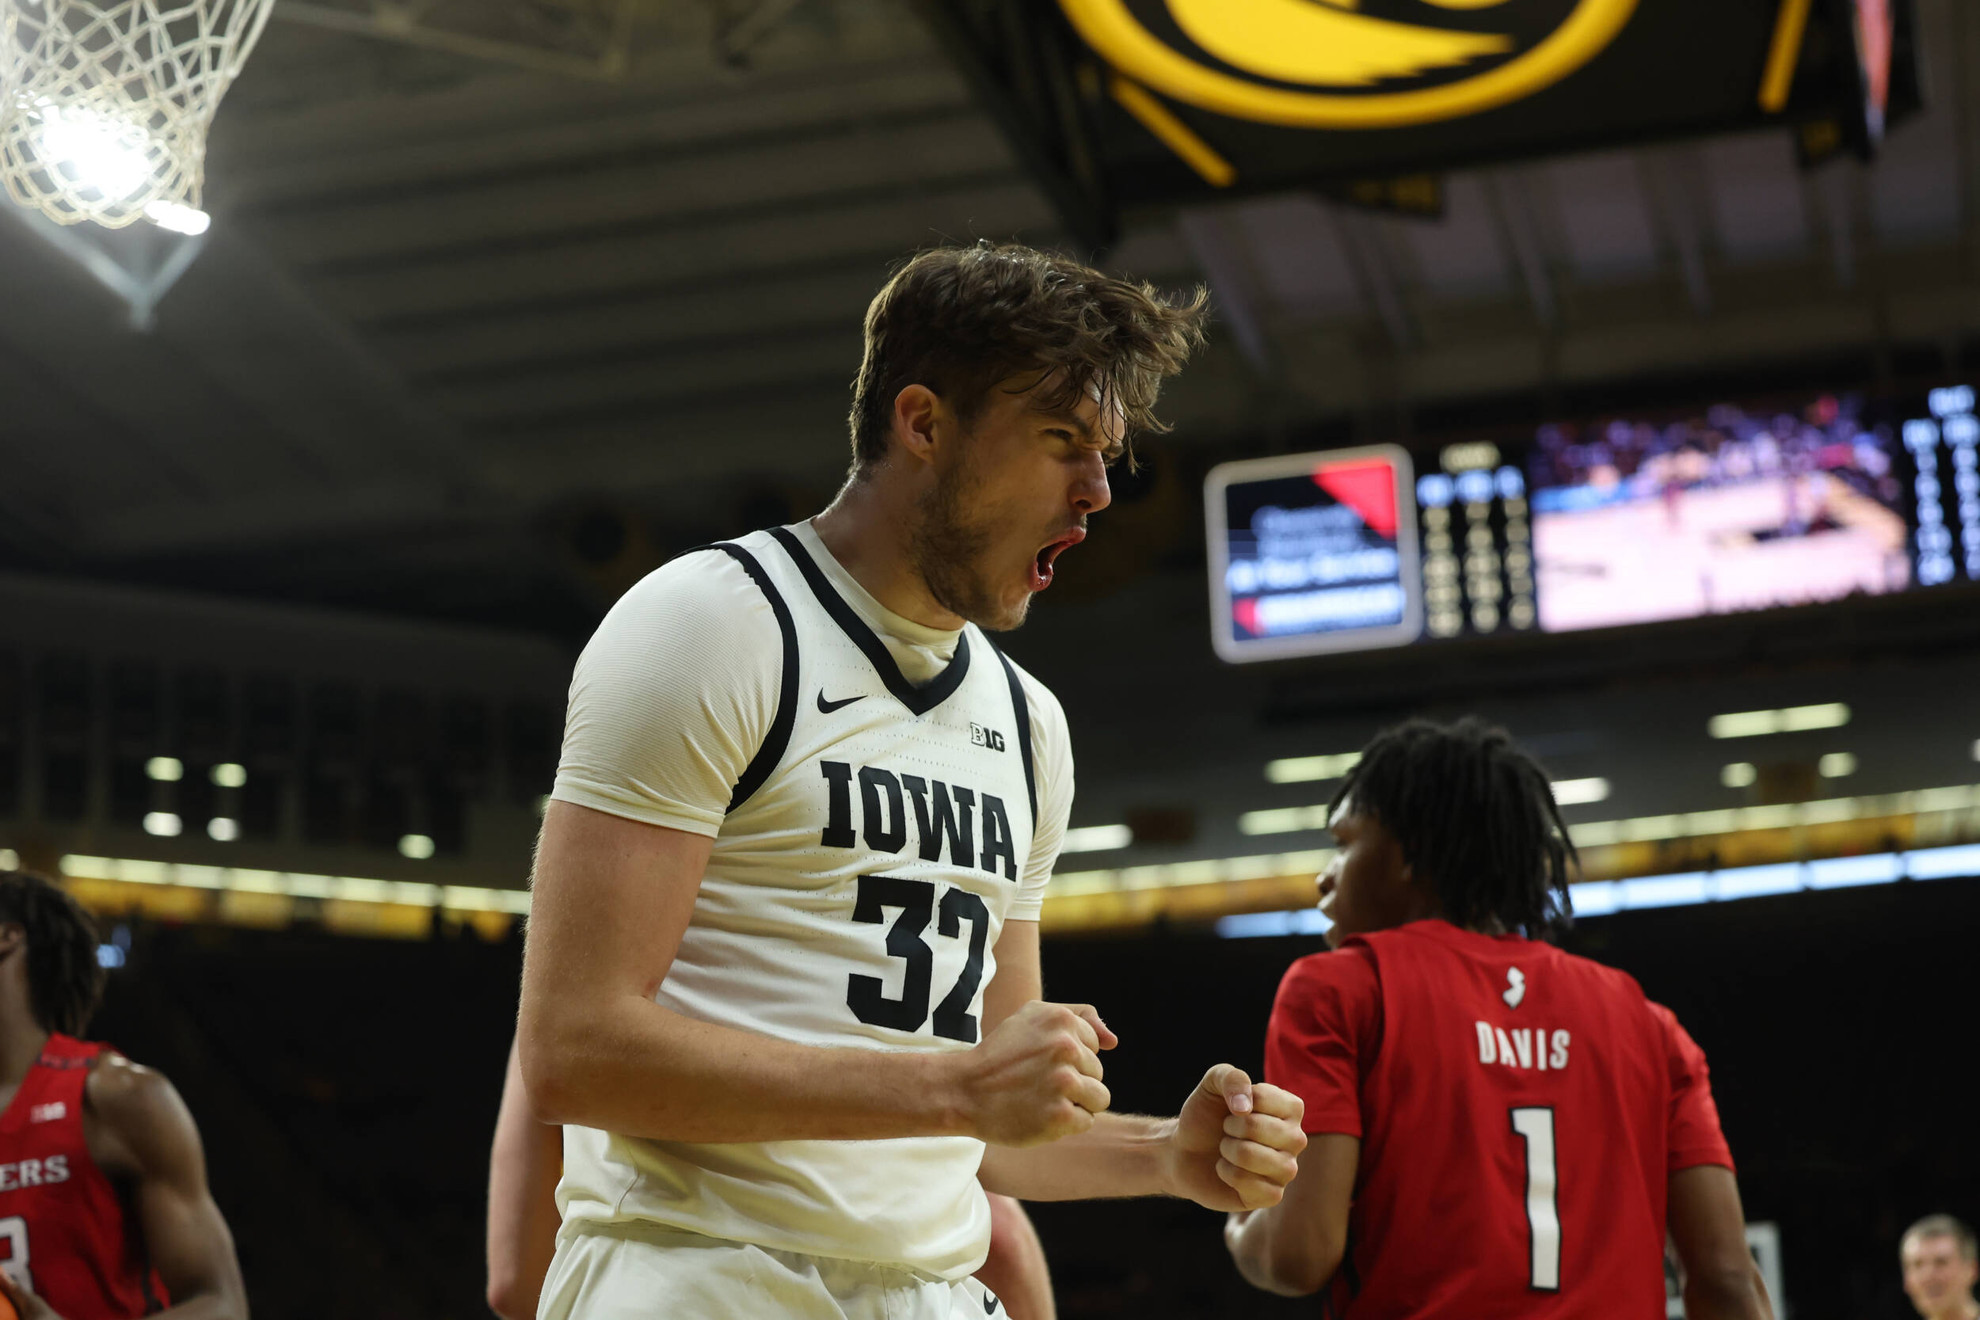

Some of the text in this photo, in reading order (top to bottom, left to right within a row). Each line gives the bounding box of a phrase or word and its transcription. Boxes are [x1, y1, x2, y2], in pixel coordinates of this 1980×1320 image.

[820, 760, 1017, 882] IOWA
[847, 875, 989, 1044] 32
[1475, 1020, 1571, 1071] DAVIS
[1509, 1106, 1561, 1292] 1
